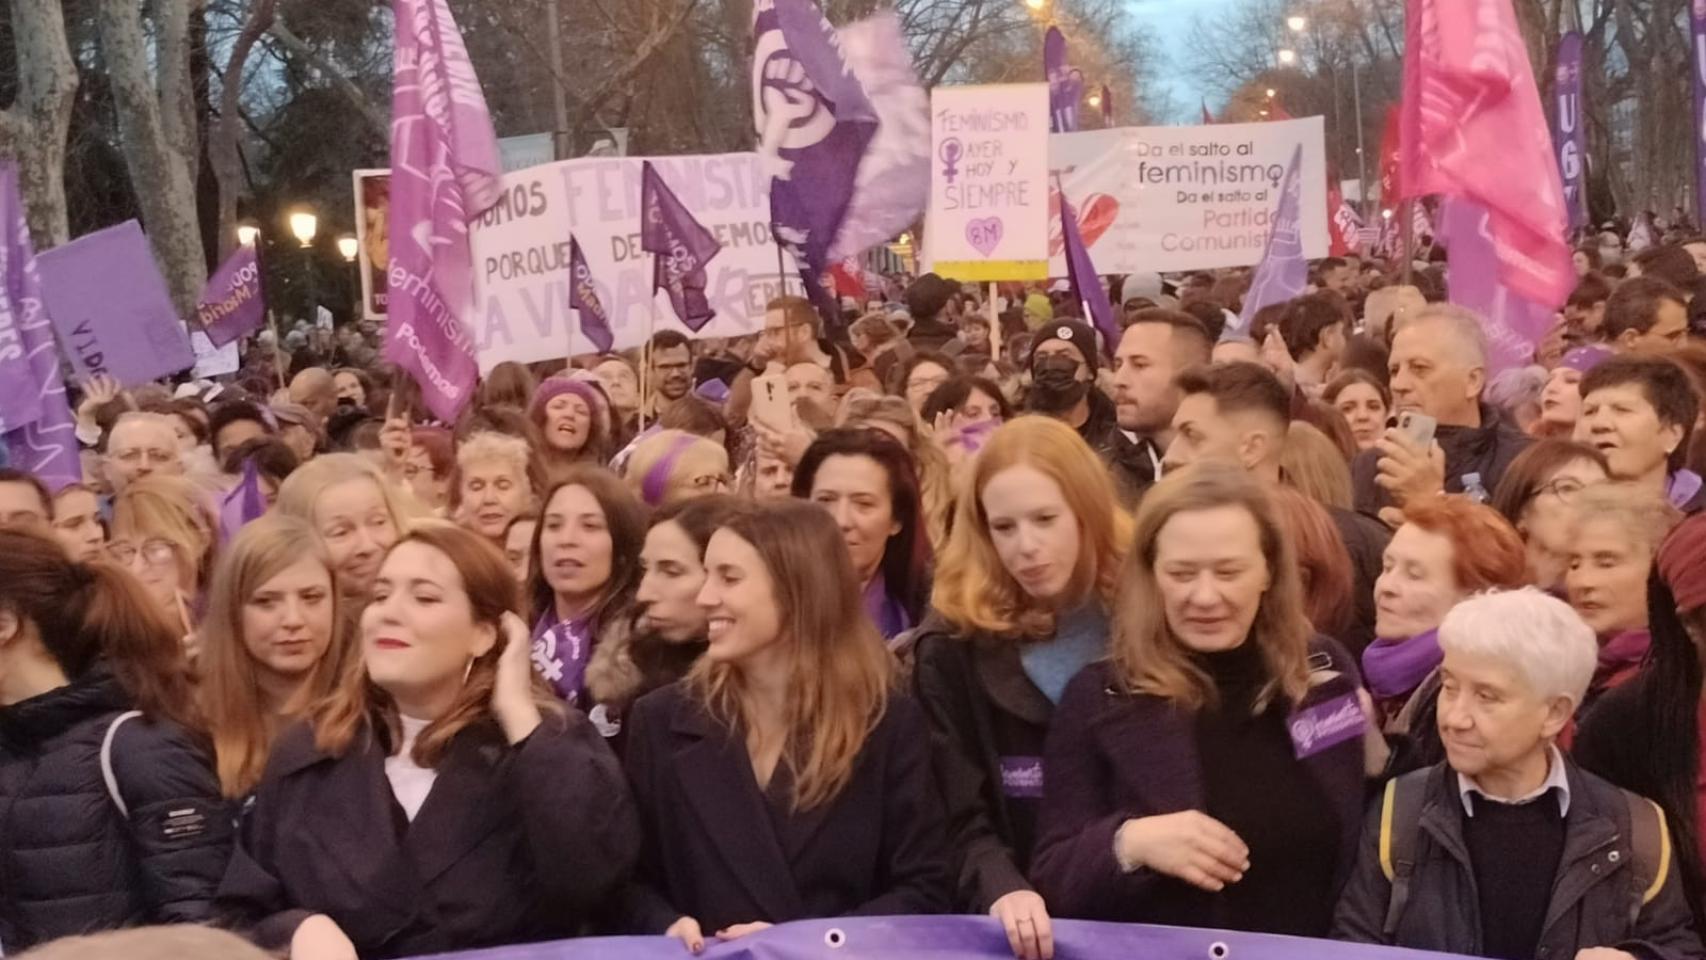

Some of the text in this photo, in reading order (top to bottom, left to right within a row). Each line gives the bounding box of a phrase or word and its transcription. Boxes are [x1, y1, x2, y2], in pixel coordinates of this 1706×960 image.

[937, 108, 1029, 132] FEMINISMO
[966, 139, 1003, 158] AYER
[1137, 141, 1253, 157] Da el salto al
[966, 159, 1018, 178] HOY Y
[1139, 160, 1284, 188] feminismo
[477, 181, 548, 230] OMOS
[944, 180, 1030, 210] SIEMPRE
[1177, 189, 1268, 203] Da el salto al
[970, 224, 998, 245] 8M
[1160, 230, 1272, 252] Comunist
